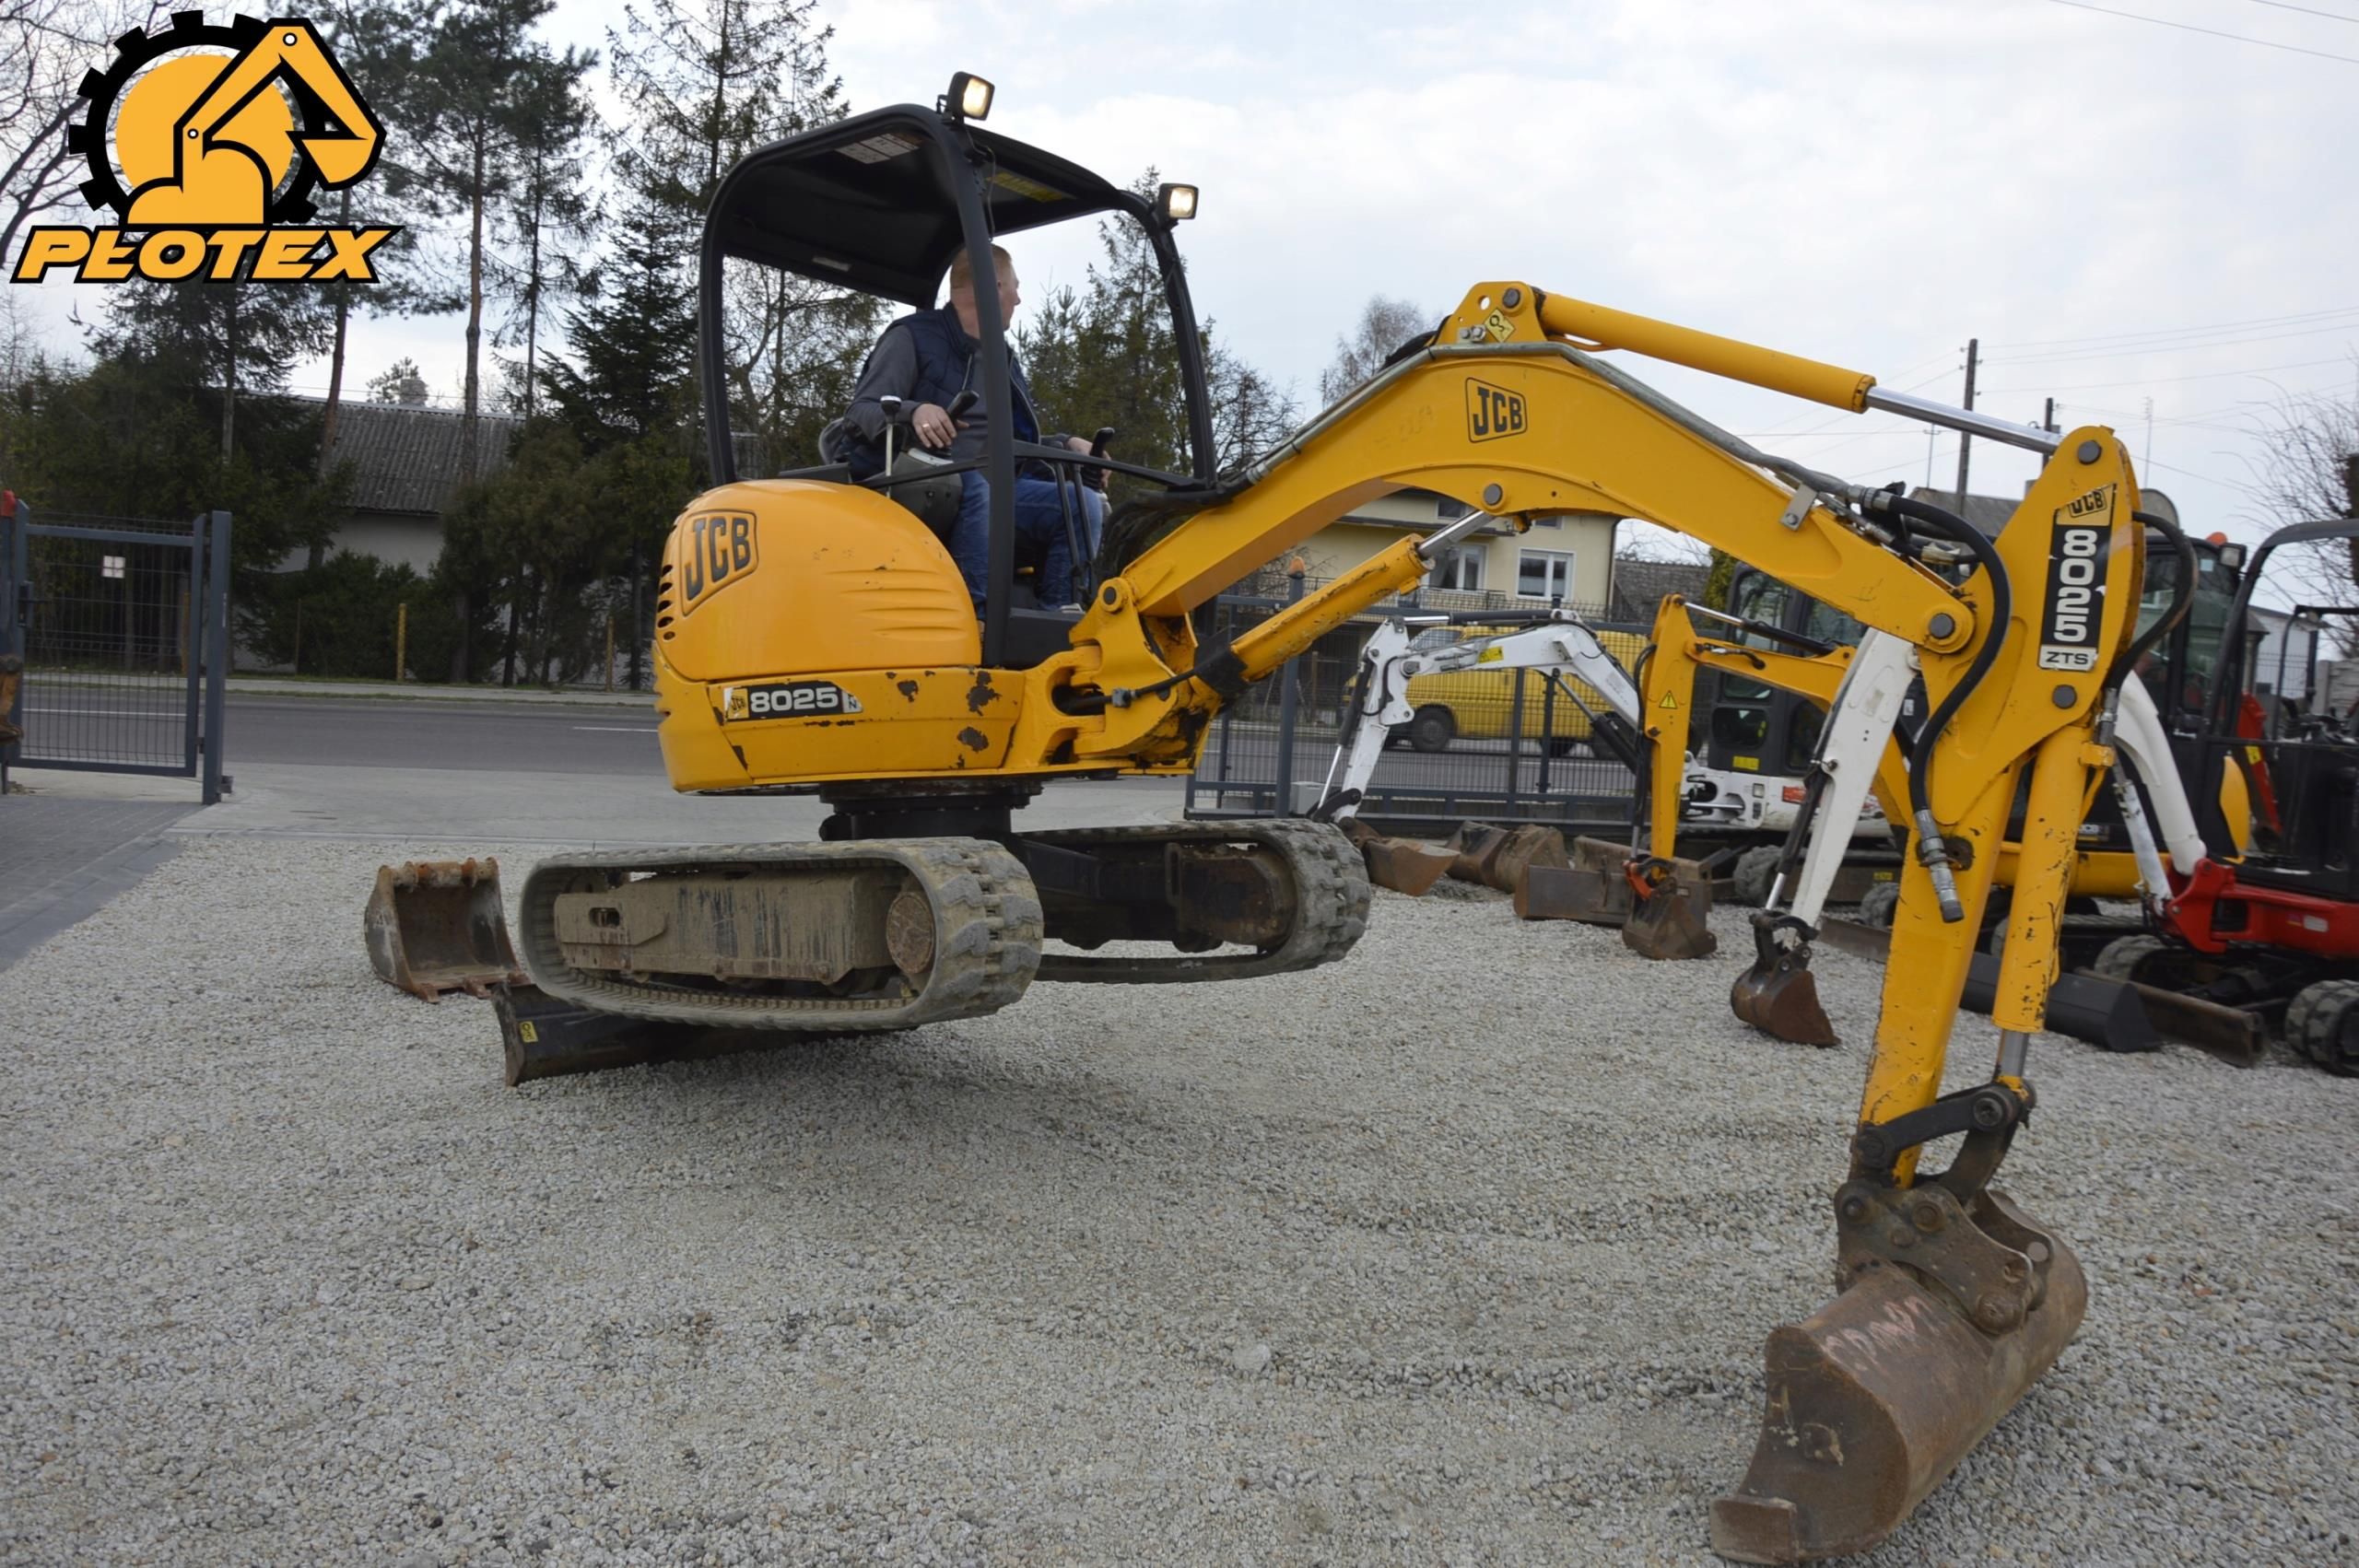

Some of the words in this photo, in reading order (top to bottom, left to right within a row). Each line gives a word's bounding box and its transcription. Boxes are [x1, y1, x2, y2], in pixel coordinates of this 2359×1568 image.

[1473, 385, 1523, 437] JCB
[685, 517, 751, 601] JCB
[2053, 529, 2098, 642] 8025
[2046, 650, 2089, 665] ZTS
[750, 686, 839, 713] 8025
